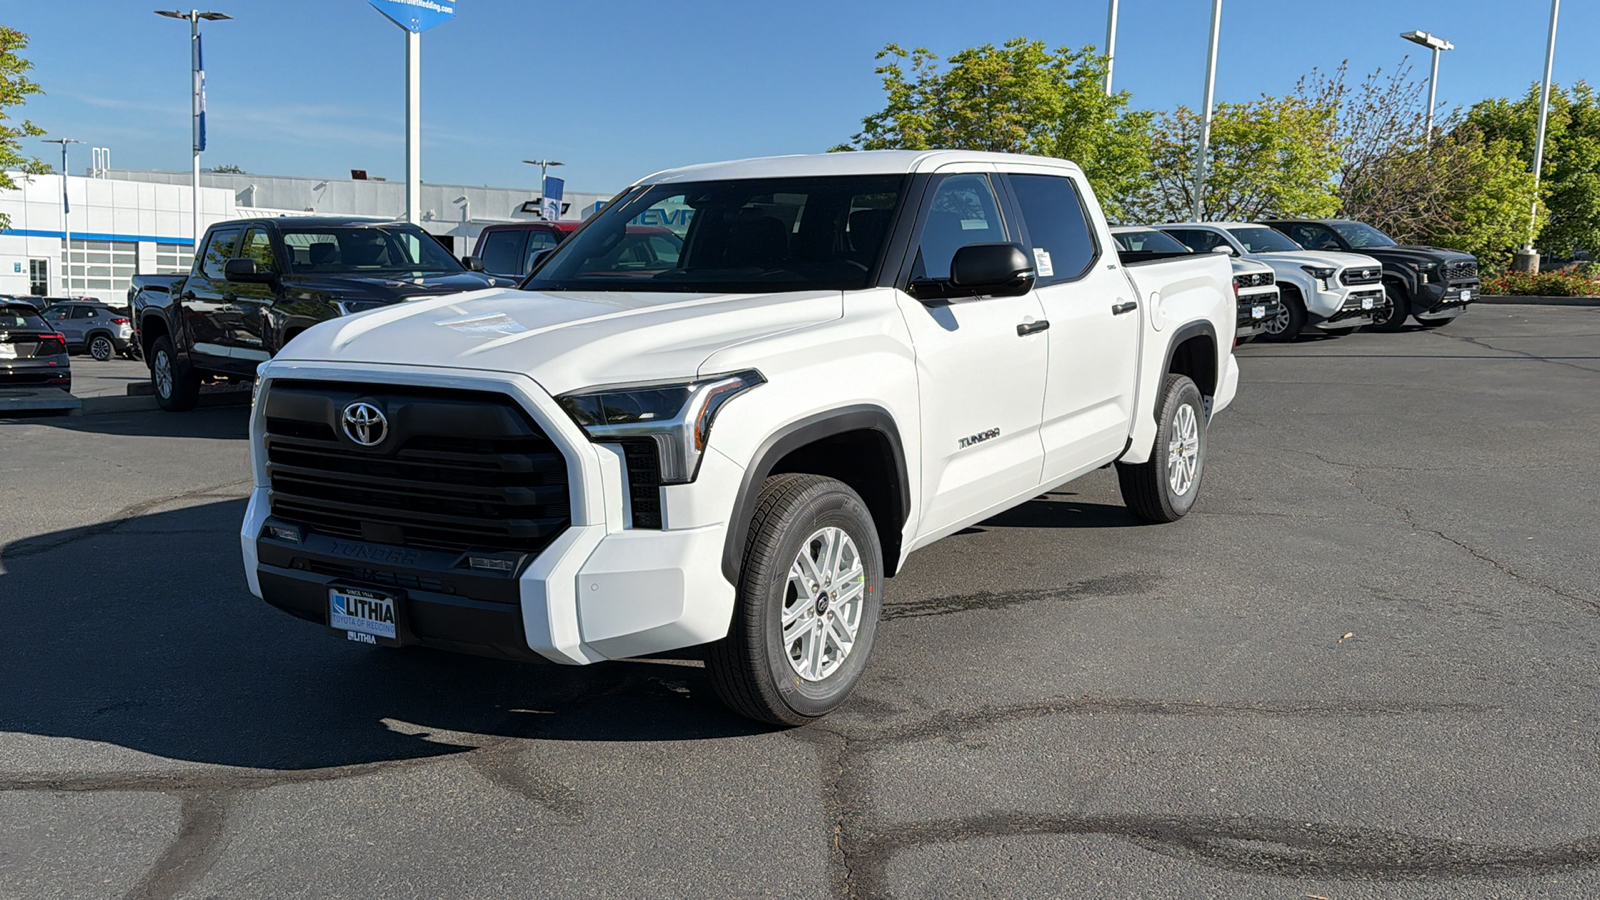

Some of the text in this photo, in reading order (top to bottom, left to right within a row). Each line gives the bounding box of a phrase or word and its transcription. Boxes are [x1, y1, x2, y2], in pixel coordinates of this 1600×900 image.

[958, 427, 1000, 449] TUNDRA
[346, 597, 394, 624] LITHIA
[333, 614, 395, 634] TOYOTA OF REDDING
[354, 631, 377, 645] LITHIA
